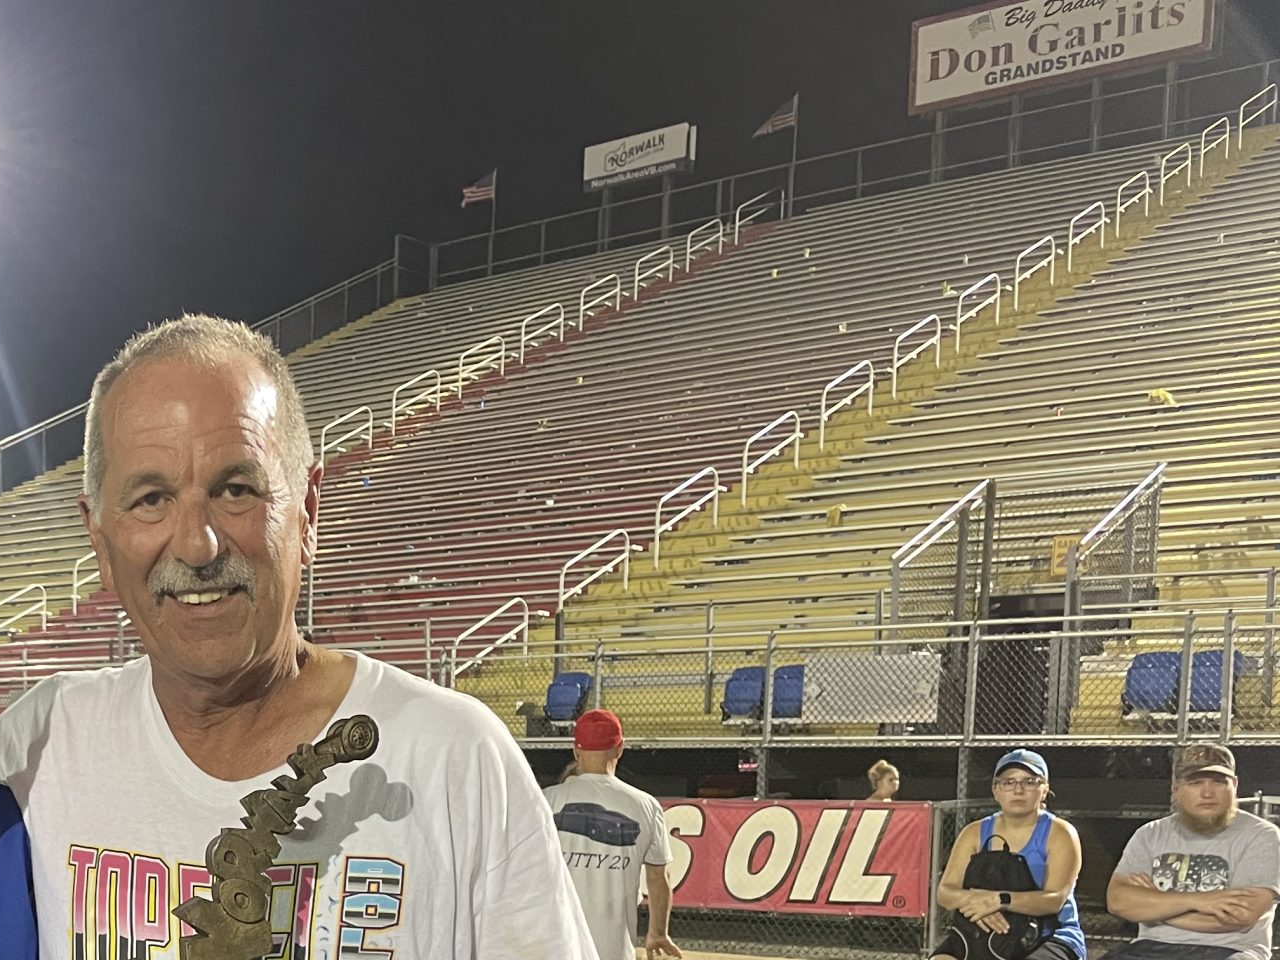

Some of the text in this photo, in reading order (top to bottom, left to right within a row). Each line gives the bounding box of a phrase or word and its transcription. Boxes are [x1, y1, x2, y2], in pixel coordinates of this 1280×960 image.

[1004, 7, 1038, 28] Big
[926, 41, 1014, 83] Don
[984, 43, 1126, 86] GRANDSTAND
[607, 133, 665, 168] NORWALK
[723, 805, 897, 905] OIL
